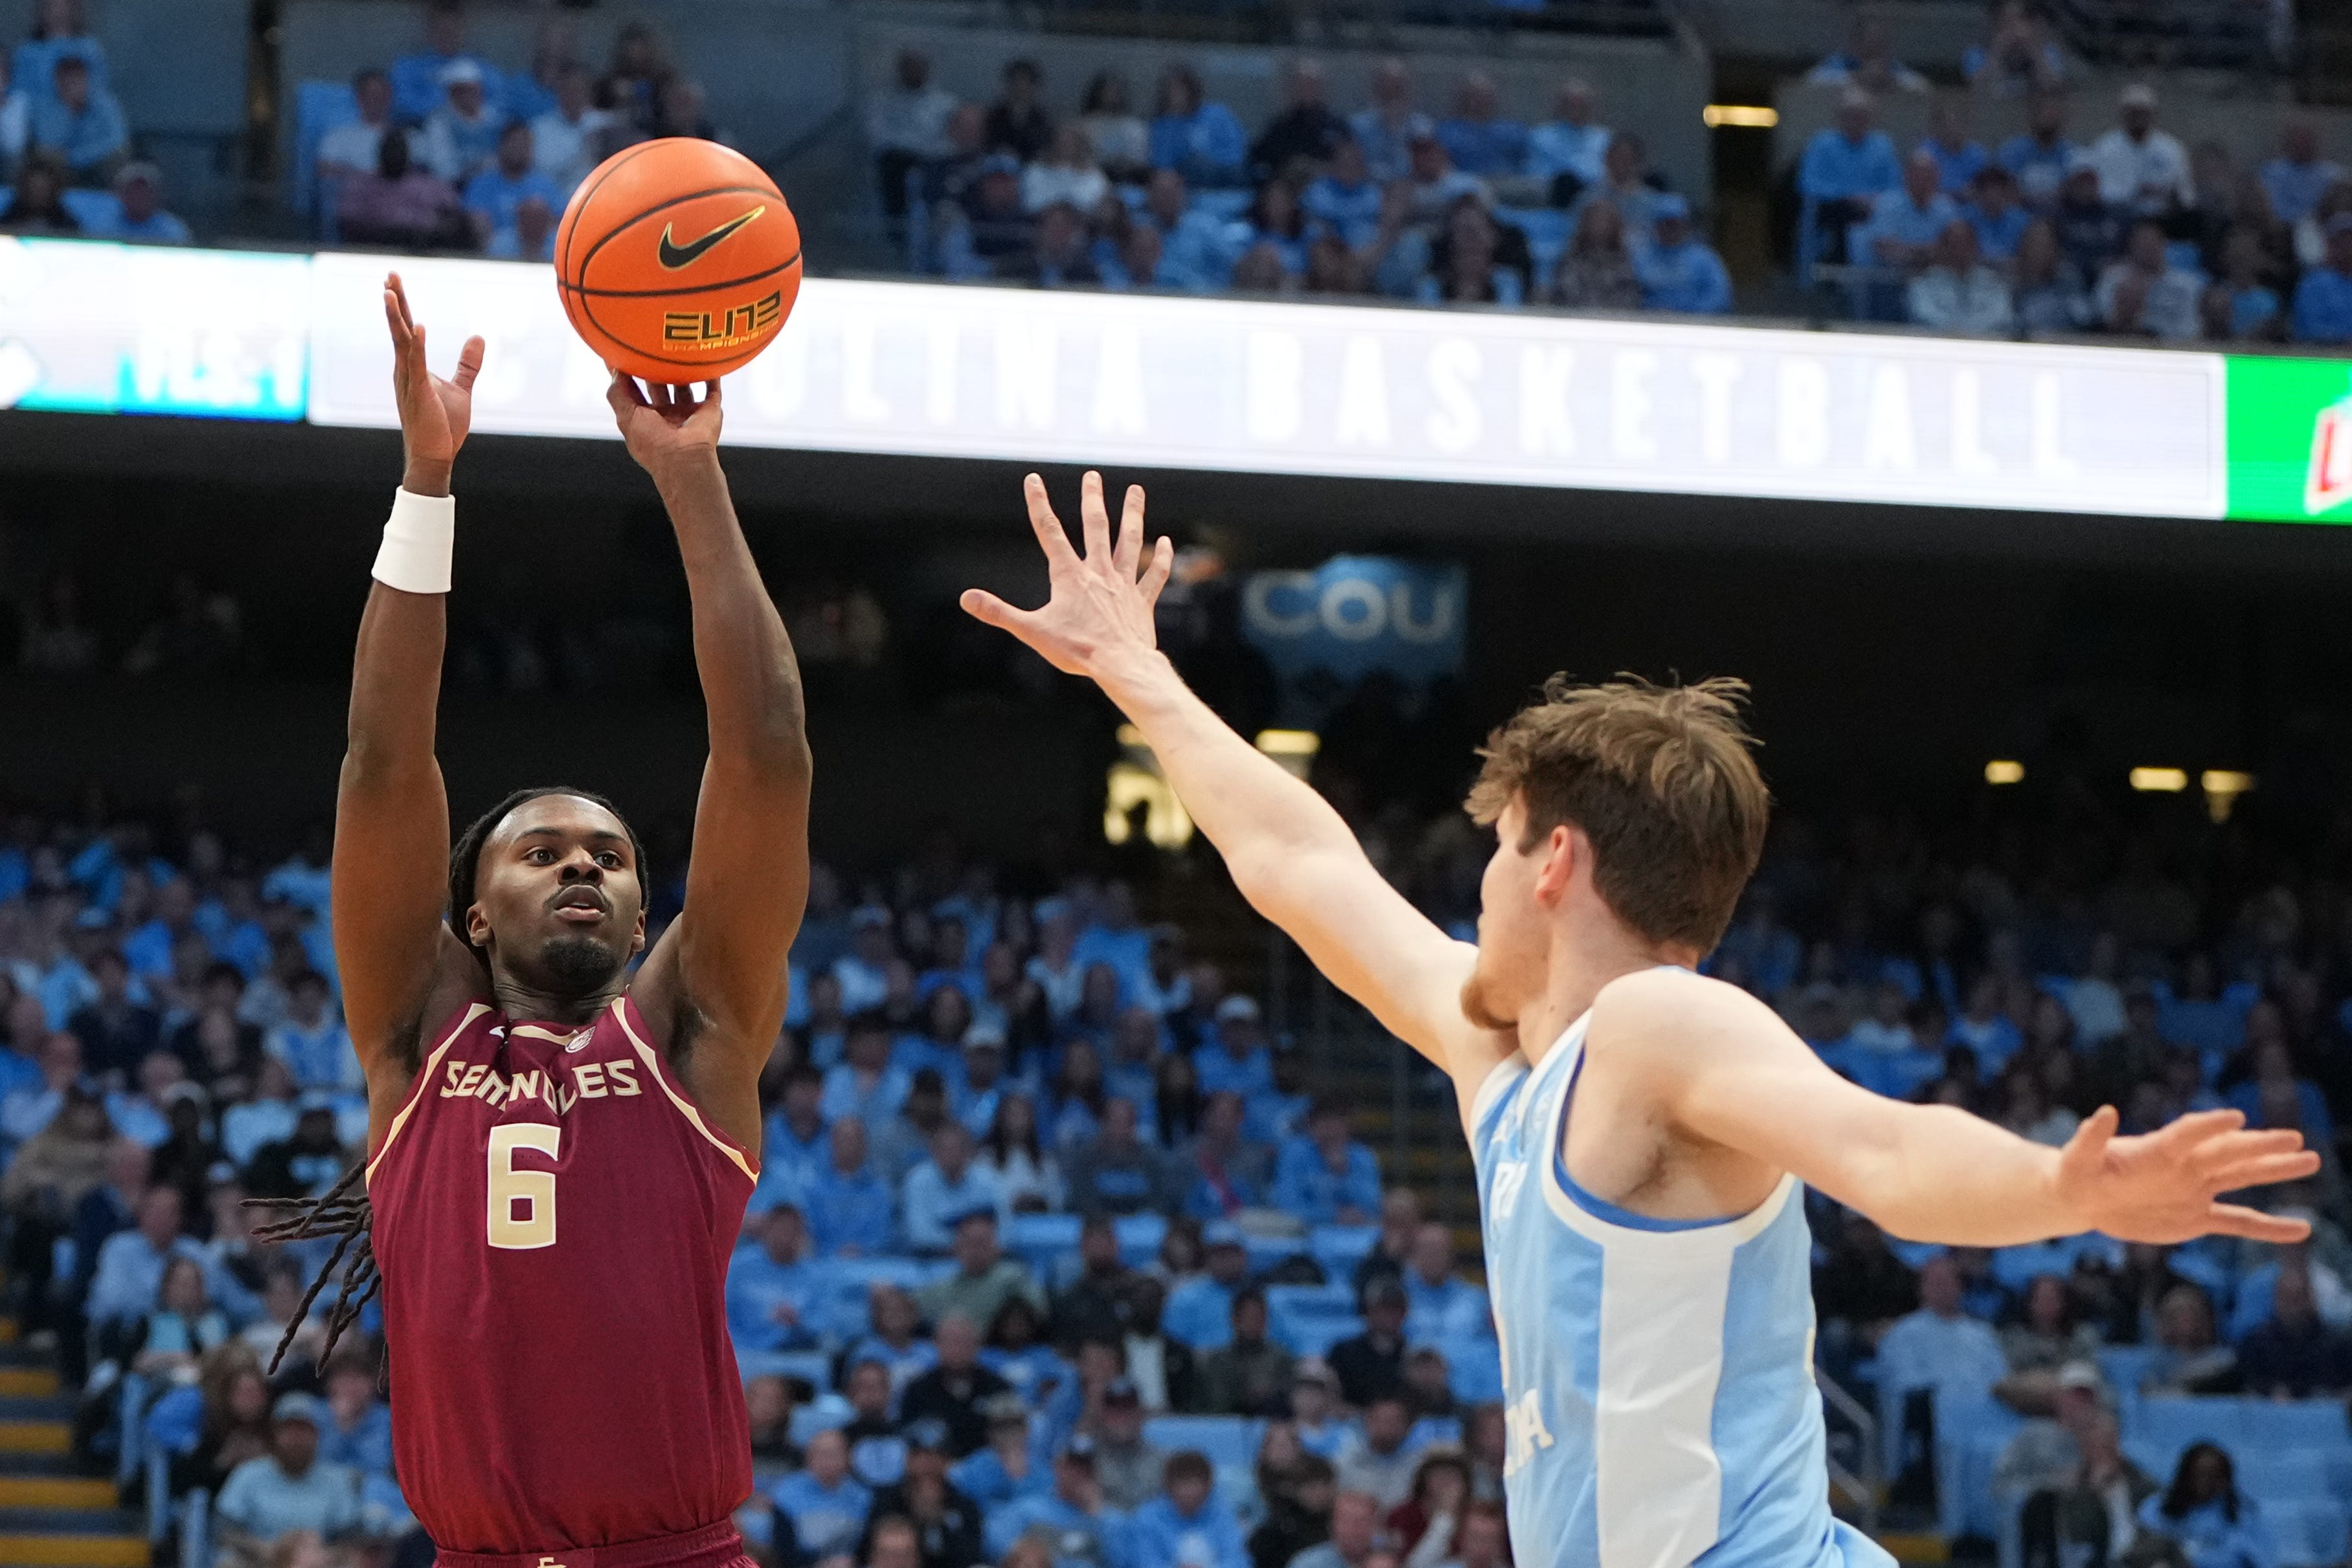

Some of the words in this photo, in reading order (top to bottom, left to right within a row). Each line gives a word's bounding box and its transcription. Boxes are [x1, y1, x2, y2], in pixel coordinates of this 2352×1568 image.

[664, 289, 782, 342] ELITE
[1245, 329, 2081, 483] BASKETBALL
[487, 1123, 561, 1249] 6
